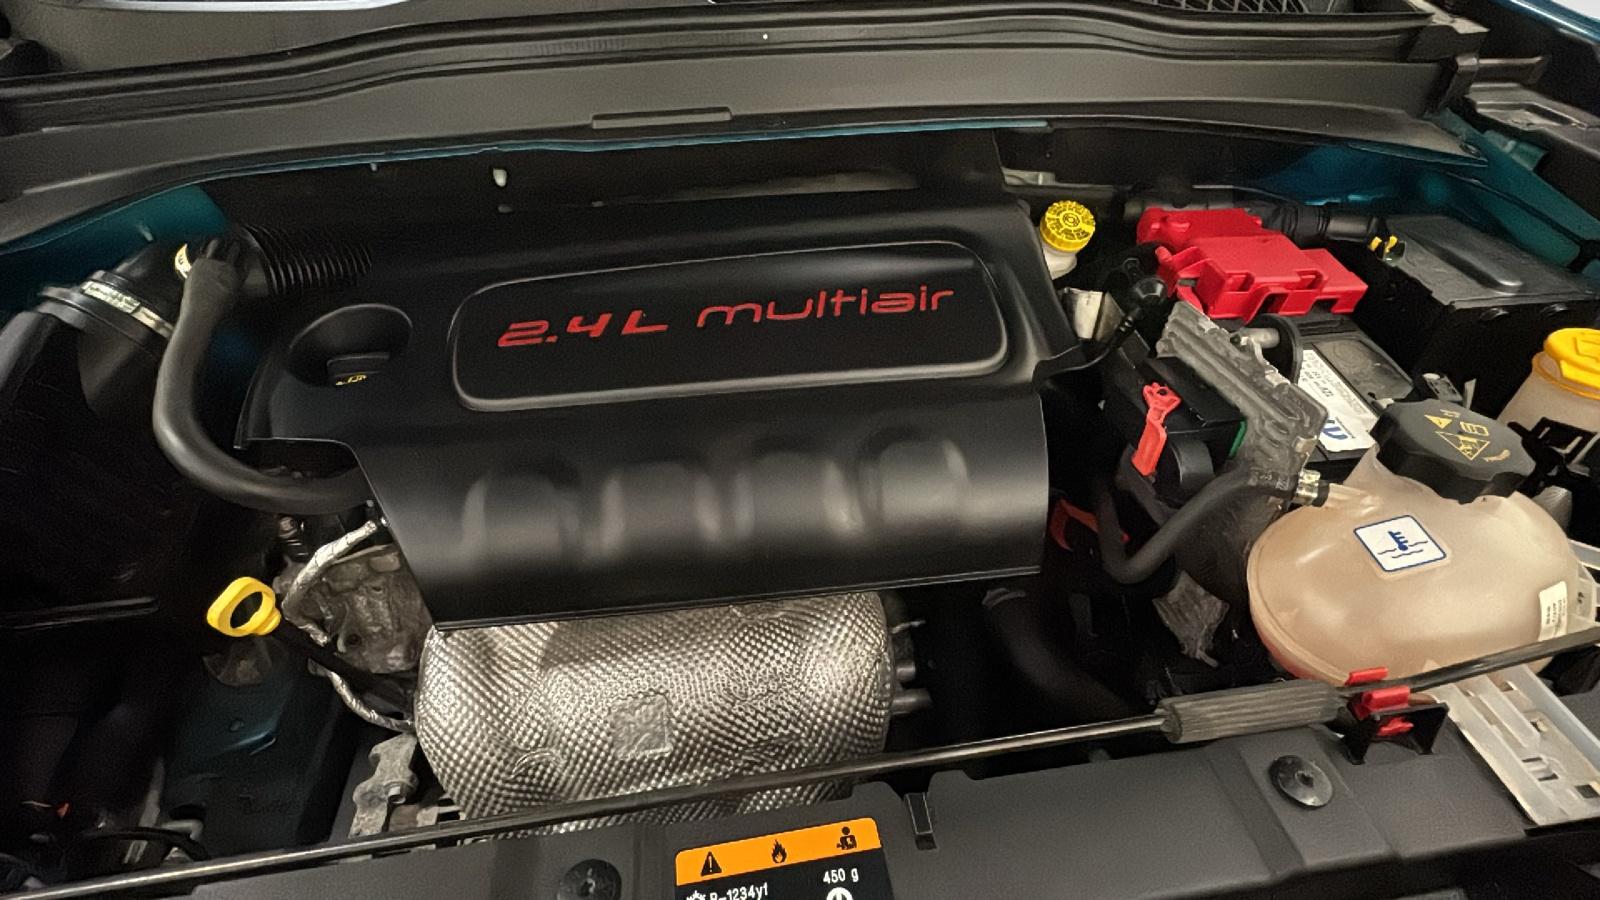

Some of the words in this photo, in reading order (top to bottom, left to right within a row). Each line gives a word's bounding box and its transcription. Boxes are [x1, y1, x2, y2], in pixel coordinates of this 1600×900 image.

[696, 284, 954, 328] multiair
[823, 868, 846, 884] 450
[851, 868, 859, 882] g
